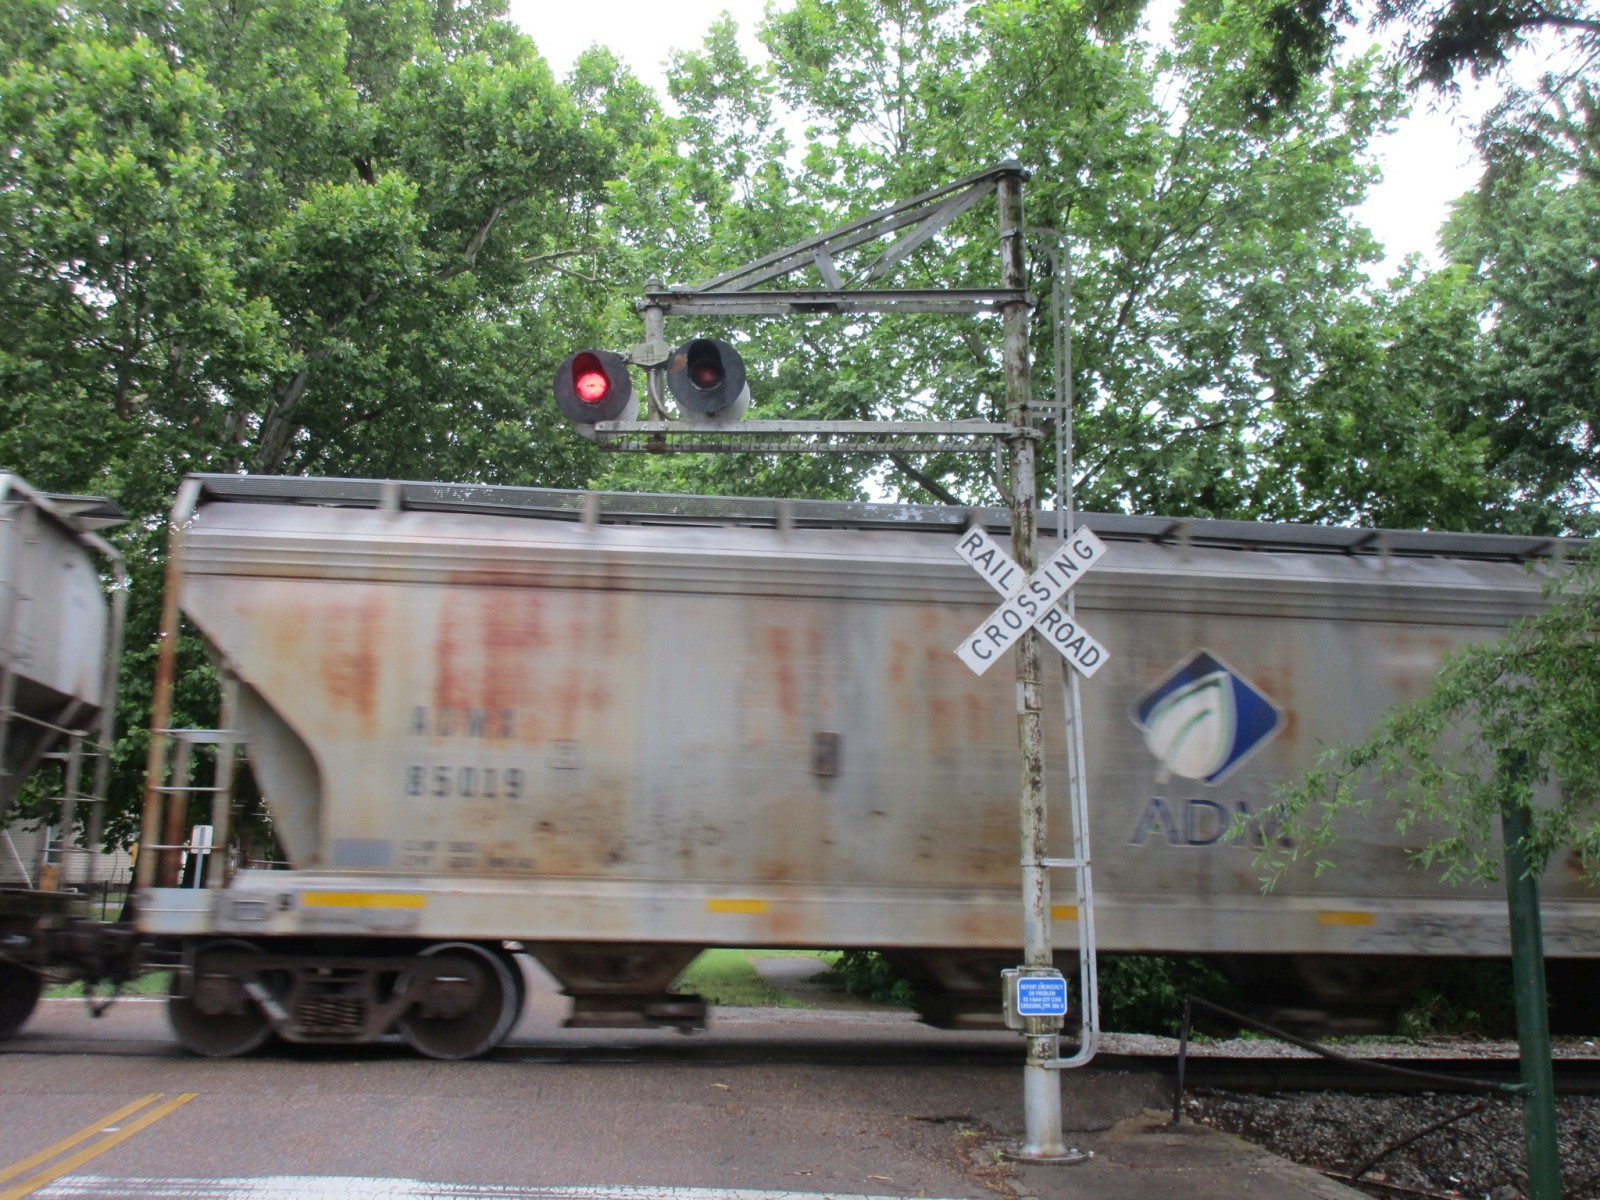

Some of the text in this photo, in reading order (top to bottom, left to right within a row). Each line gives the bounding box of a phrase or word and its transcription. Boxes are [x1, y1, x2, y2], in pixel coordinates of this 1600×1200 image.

[961, 532, 1100, 667] RAIL ROAD
[971, 540, 1094, 660] CROSSING
[405, 765, 524, 798] 85019
